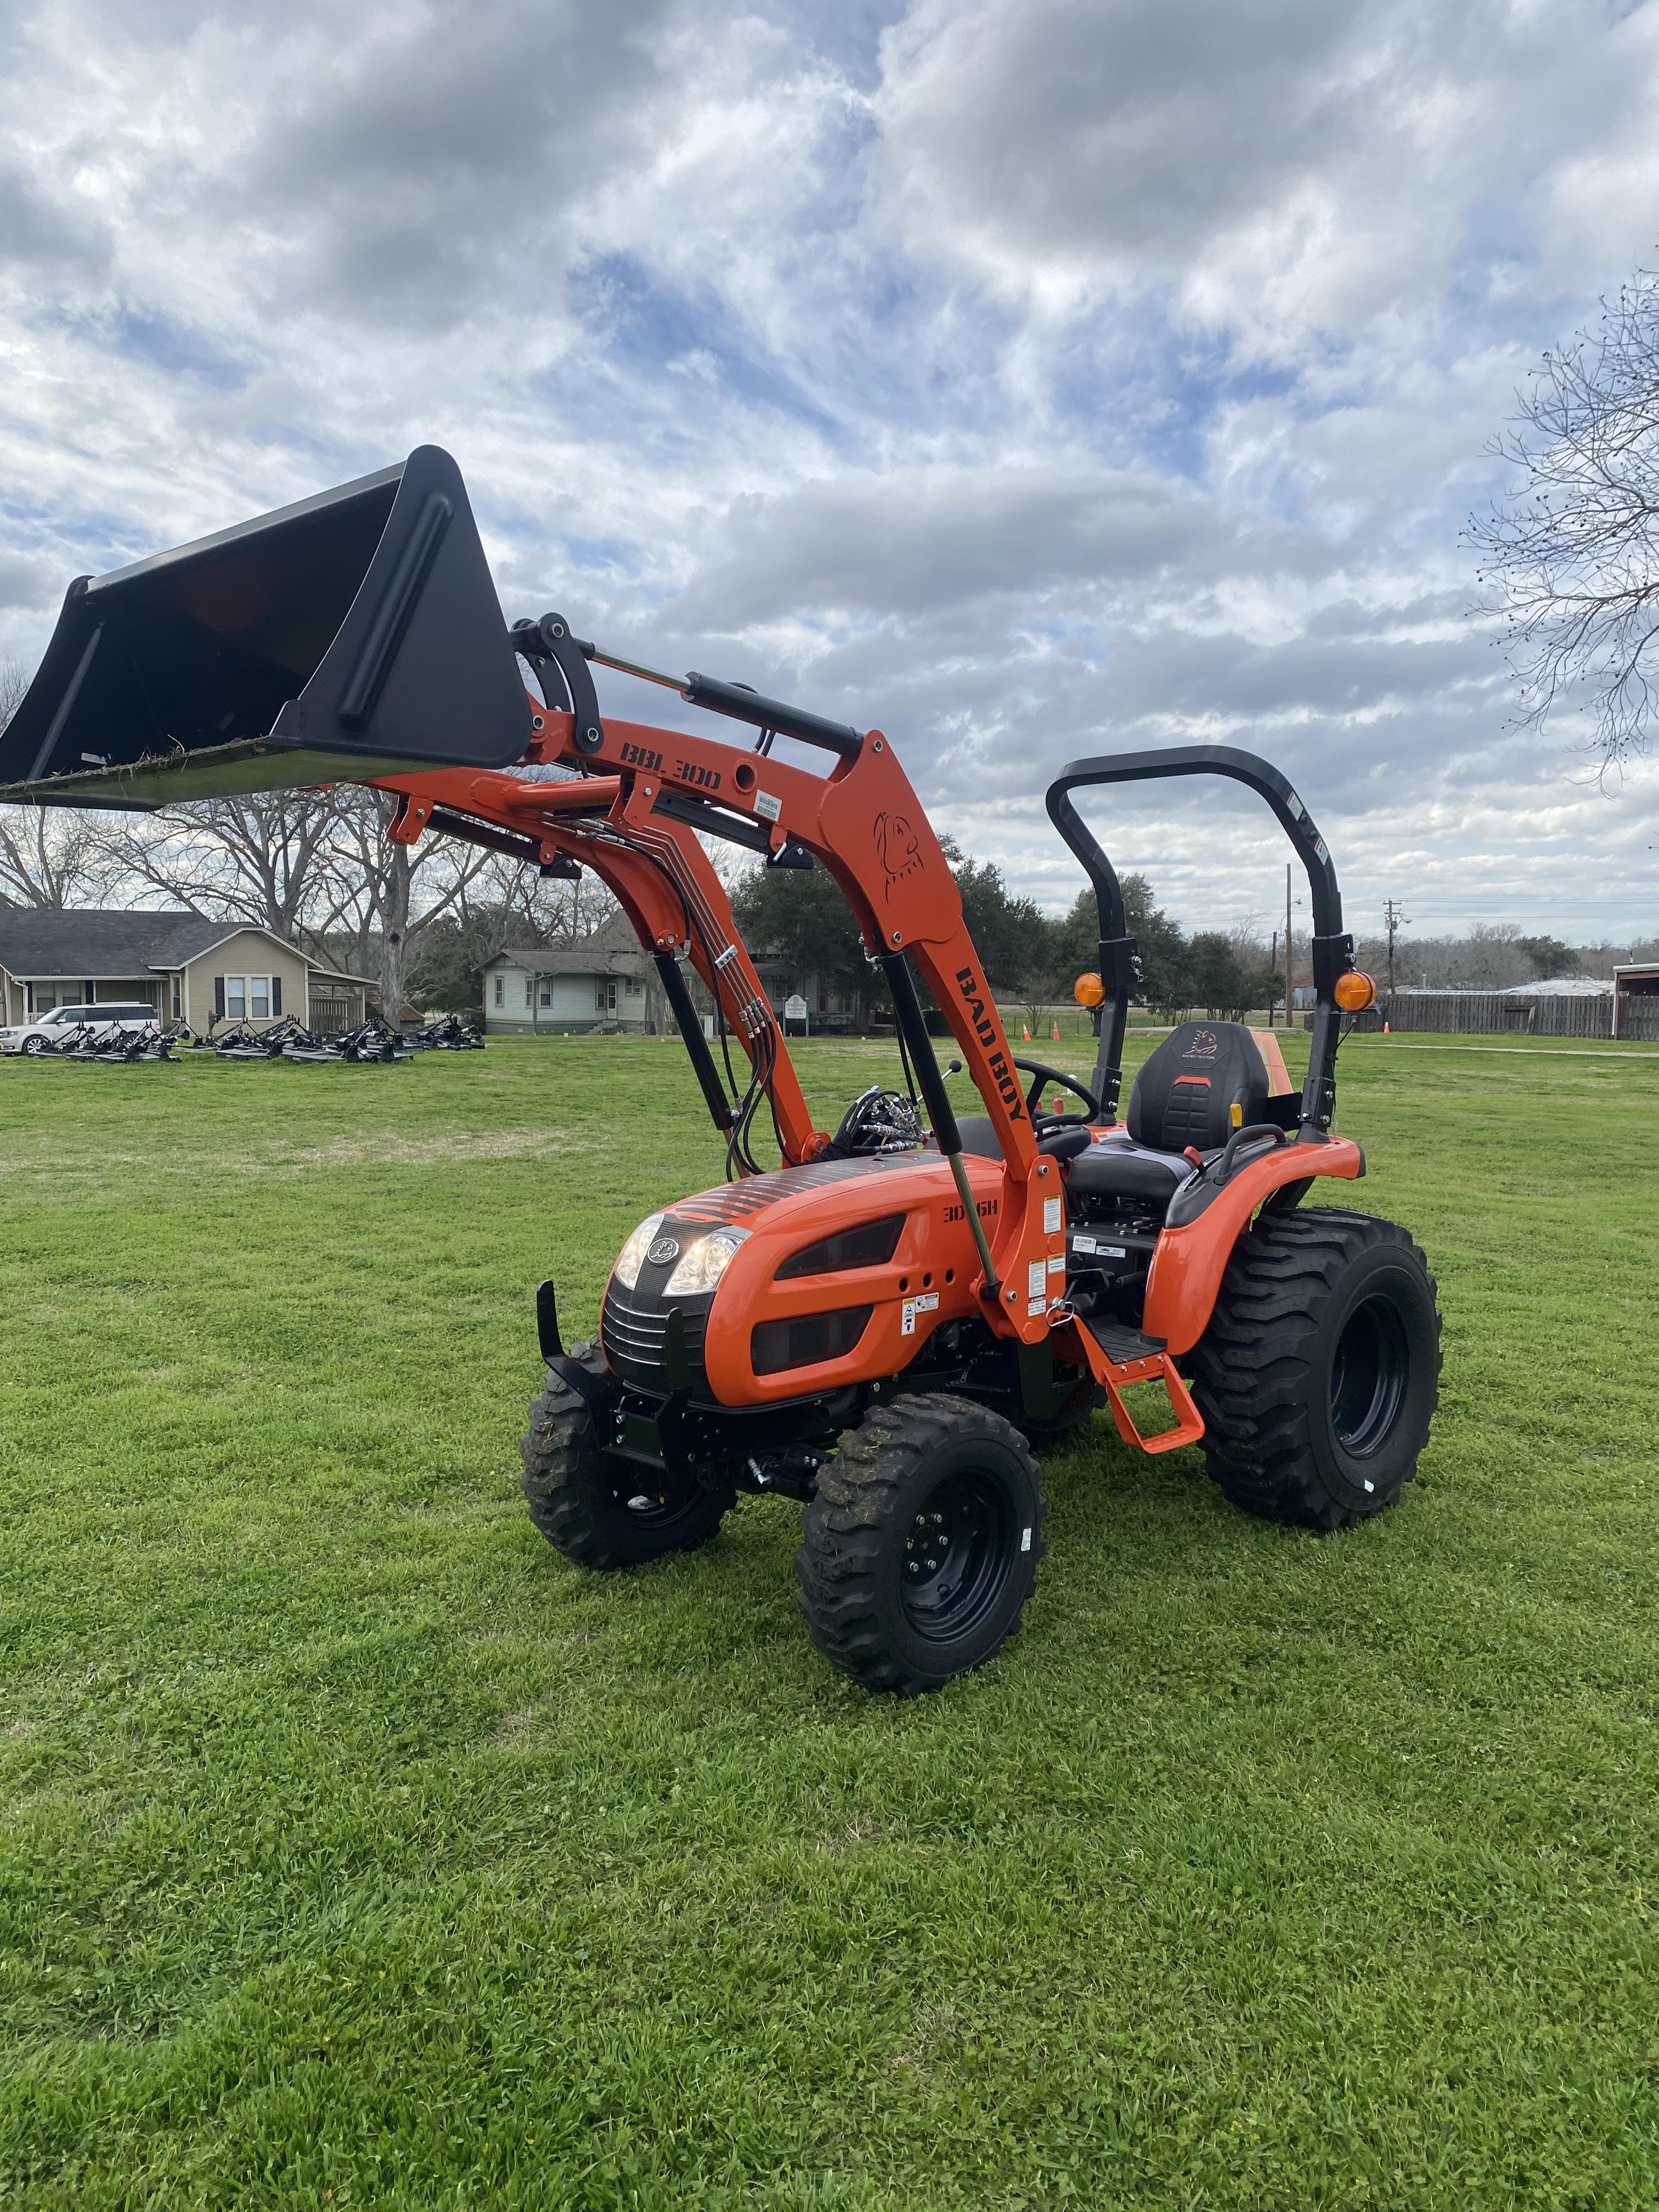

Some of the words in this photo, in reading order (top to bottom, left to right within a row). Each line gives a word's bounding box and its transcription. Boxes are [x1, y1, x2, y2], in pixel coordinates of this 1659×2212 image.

[620, 742, 665, 773] BBL
[673, 759, 721, 790] 300
[956, 967, 996, 1047] BAD
[989, 1051, 1028, 1121] BOY
[943, 1199, 997, 1223] 306H
